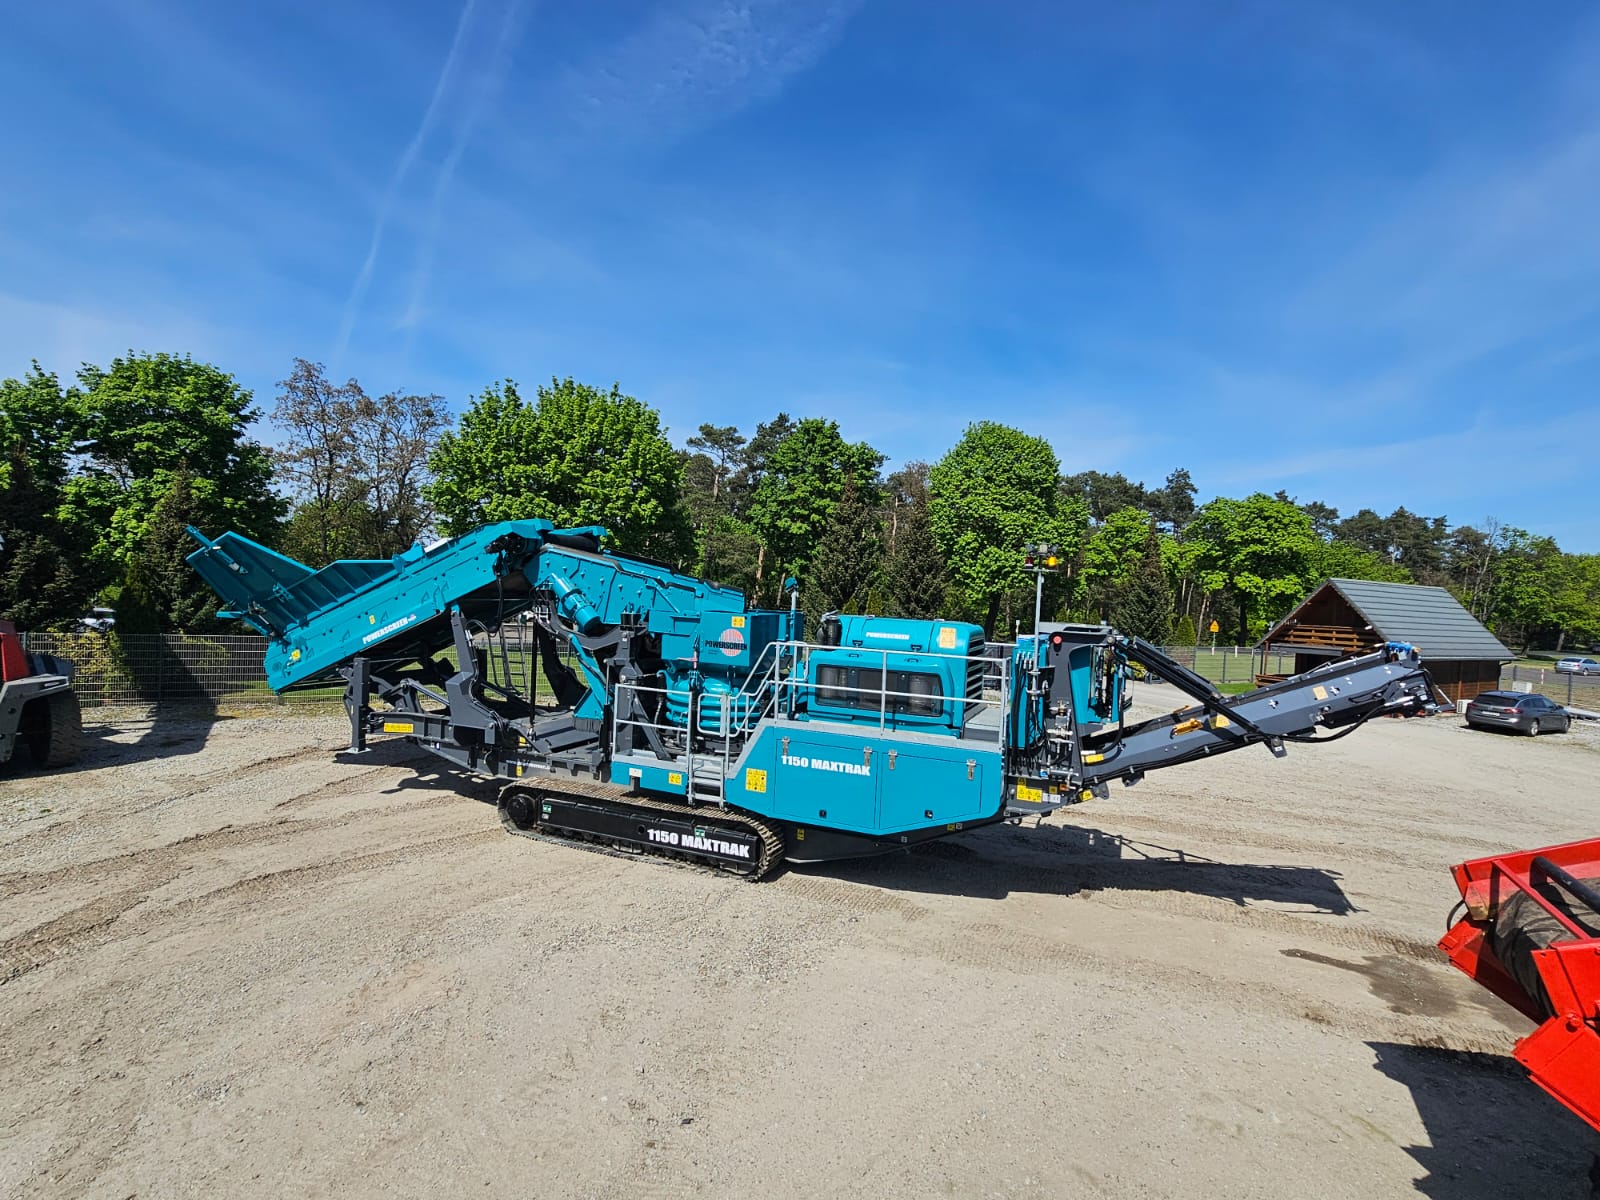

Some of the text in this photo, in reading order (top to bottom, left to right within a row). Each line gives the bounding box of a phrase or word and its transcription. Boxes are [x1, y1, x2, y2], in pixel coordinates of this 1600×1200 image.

[362, 616, 408, 645] POWERSCREEN
[704, 640, 747, 650] POWERSCREEN
[781, 755, 870, 776] 1150 MAXTRAK
[647, 829, 750, 858] 1150 MAXTRAK
